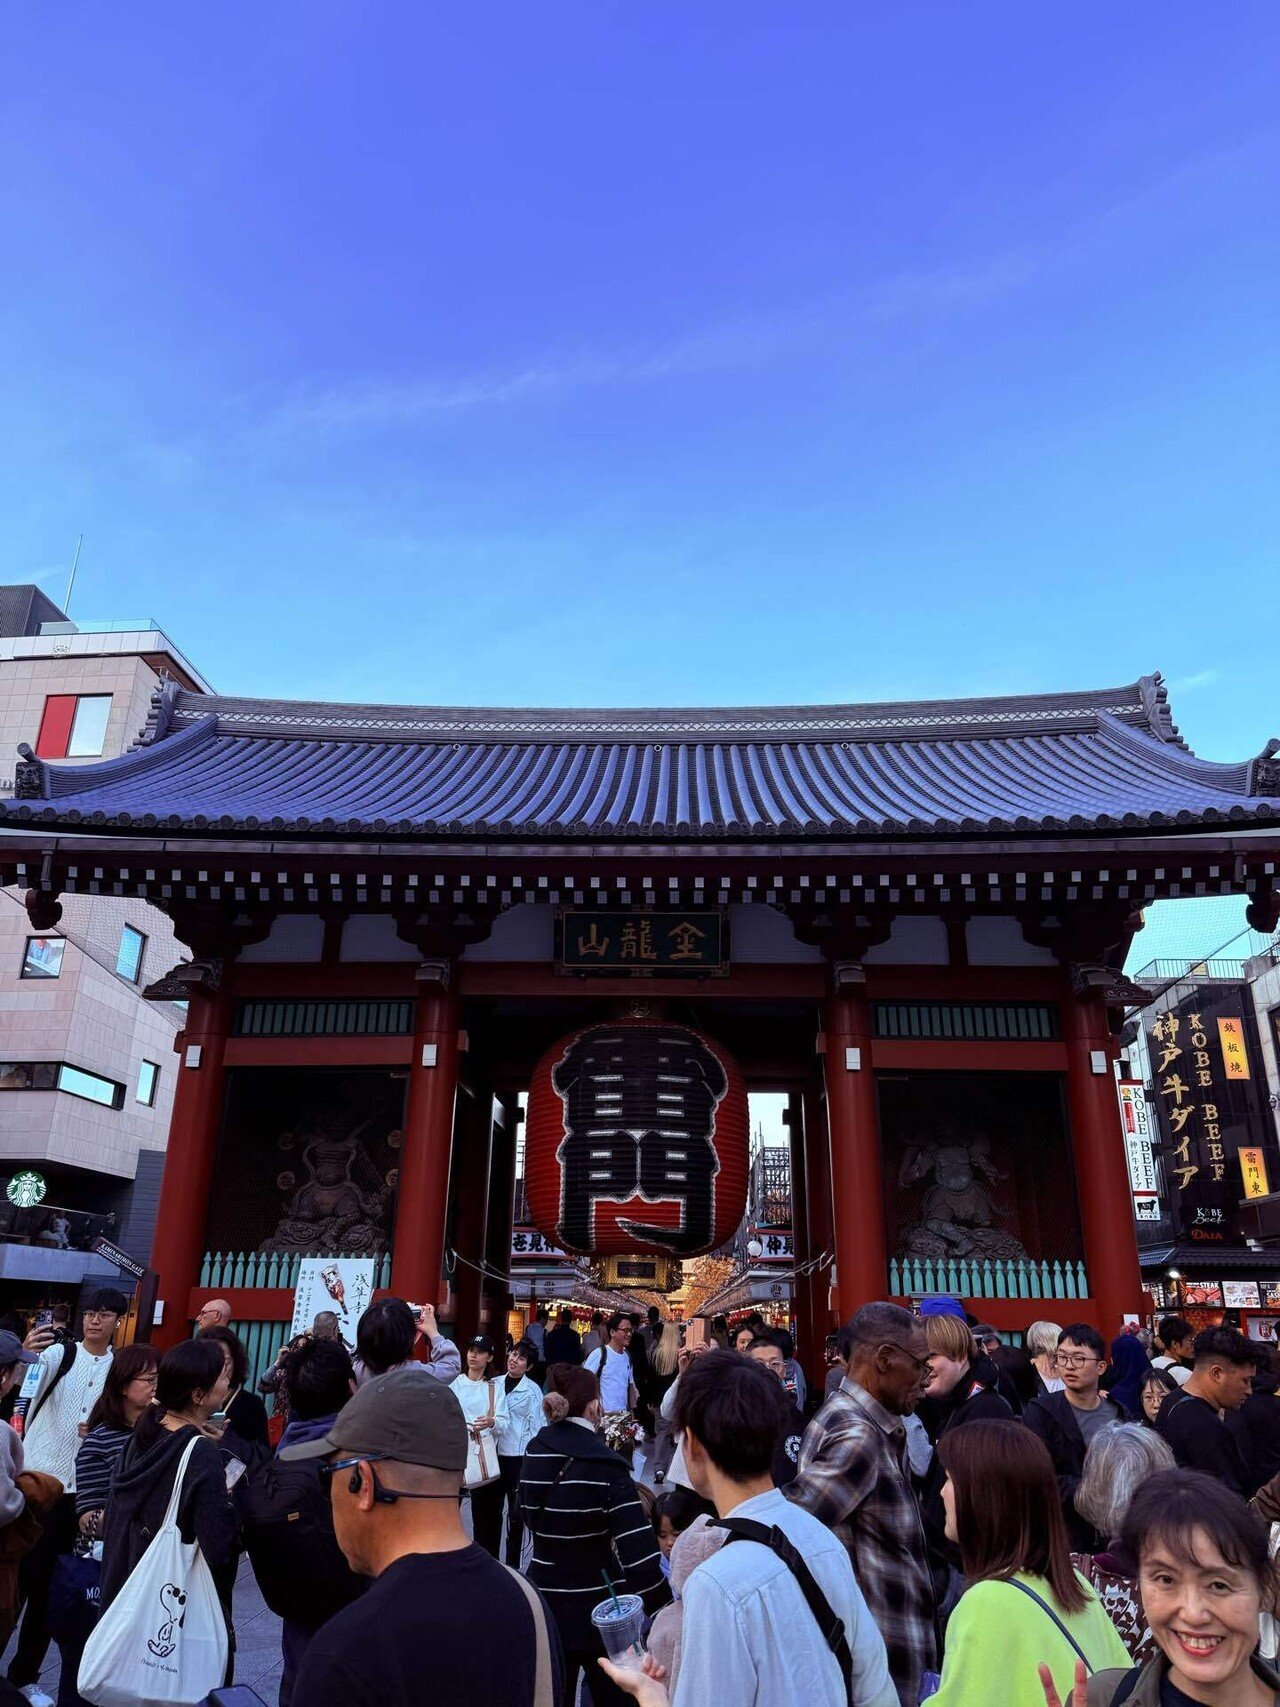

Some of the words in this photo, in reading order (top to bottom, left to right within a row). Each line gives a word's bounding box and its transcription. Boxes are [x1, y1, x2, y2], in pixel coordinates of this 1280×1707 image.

[551, 1024, 728, 1254] 雷門
[1133, 1088, 1148, 1135] KOBE
[1141, 1141, 1155, 1189] BEEF
[1152, 1012, 1199, 1190] 神戸牛ダイア
[1188, 1013, 1213, 1087] KOBE
[1201, 1103, 1225, 1181] BEEF
[1245, 1151, 1263, 1194] 雷門東
